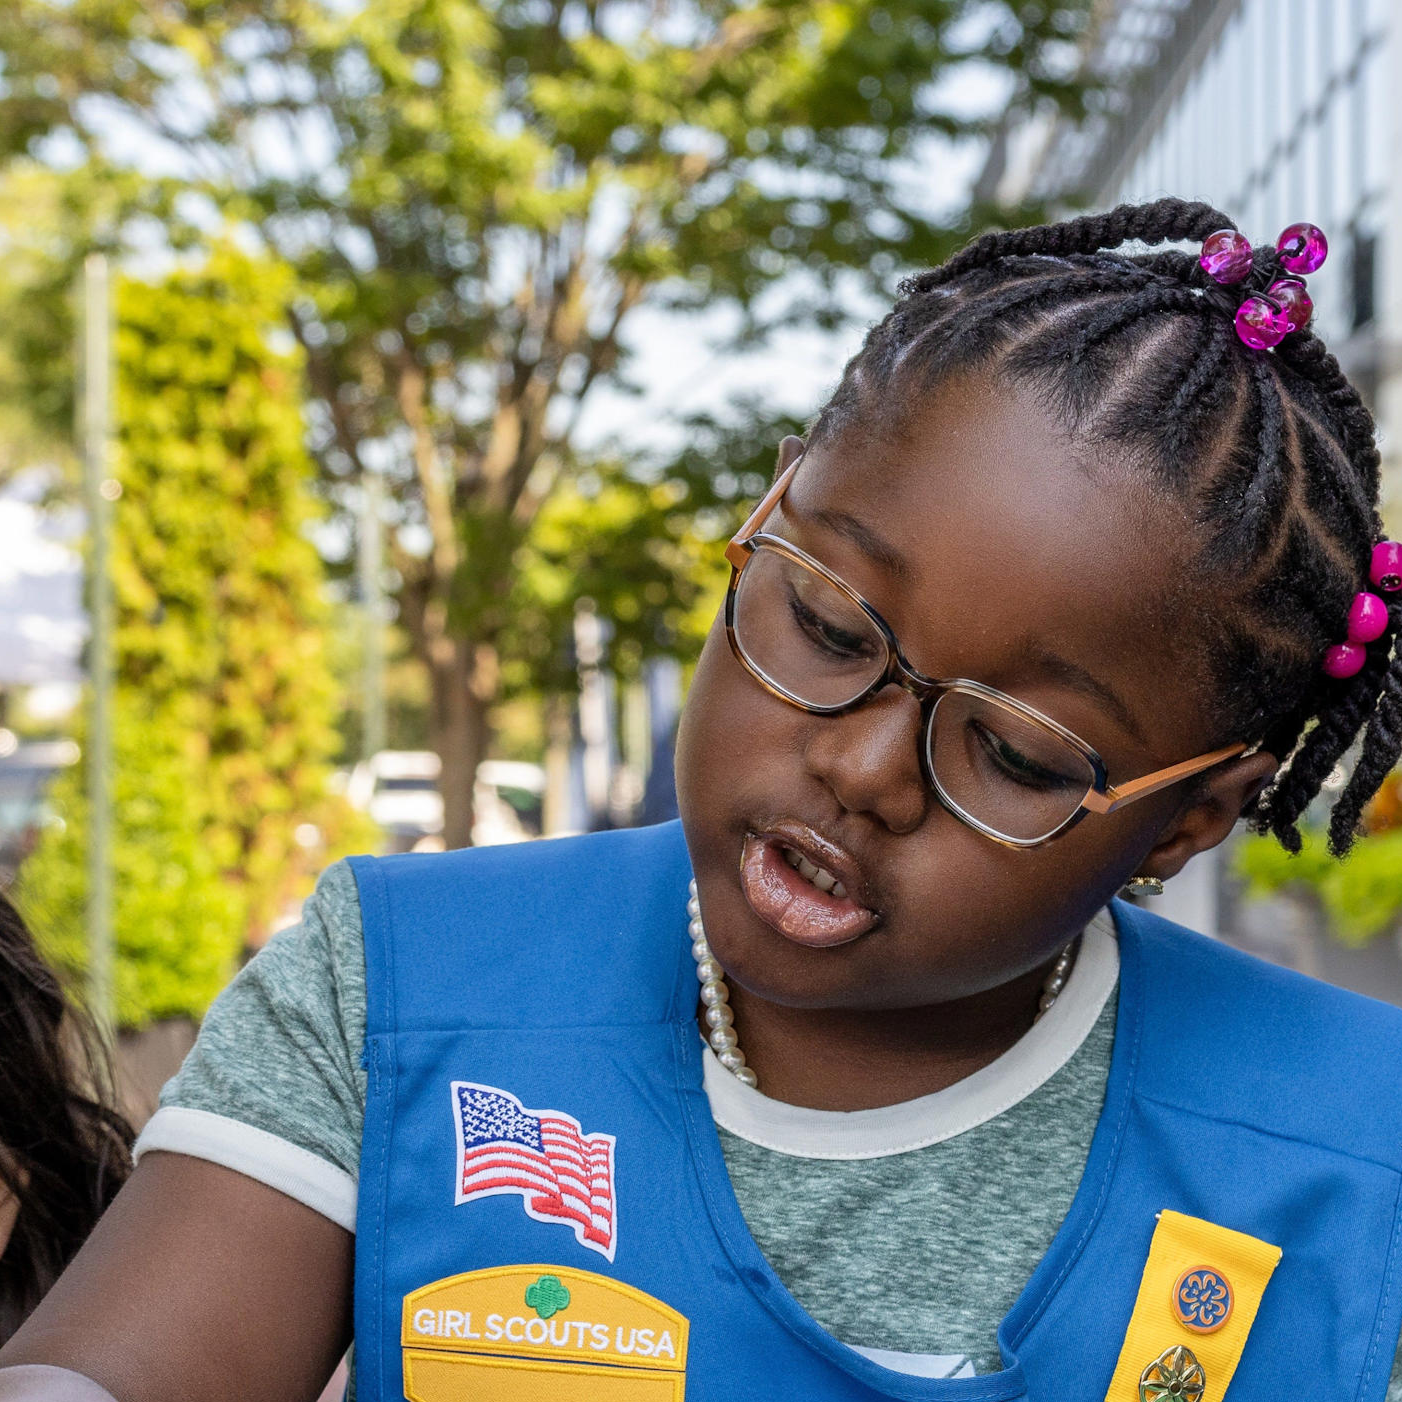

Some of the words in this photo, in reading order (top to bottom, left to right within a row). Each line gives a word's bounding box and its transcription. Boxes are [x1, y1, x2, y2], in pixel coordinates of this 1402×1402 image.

[413, 1308, 481, 1340] GIRL
[485, 1313, 610, 1351] SCOUTS
[616, 1326, 676, 1358] USA
